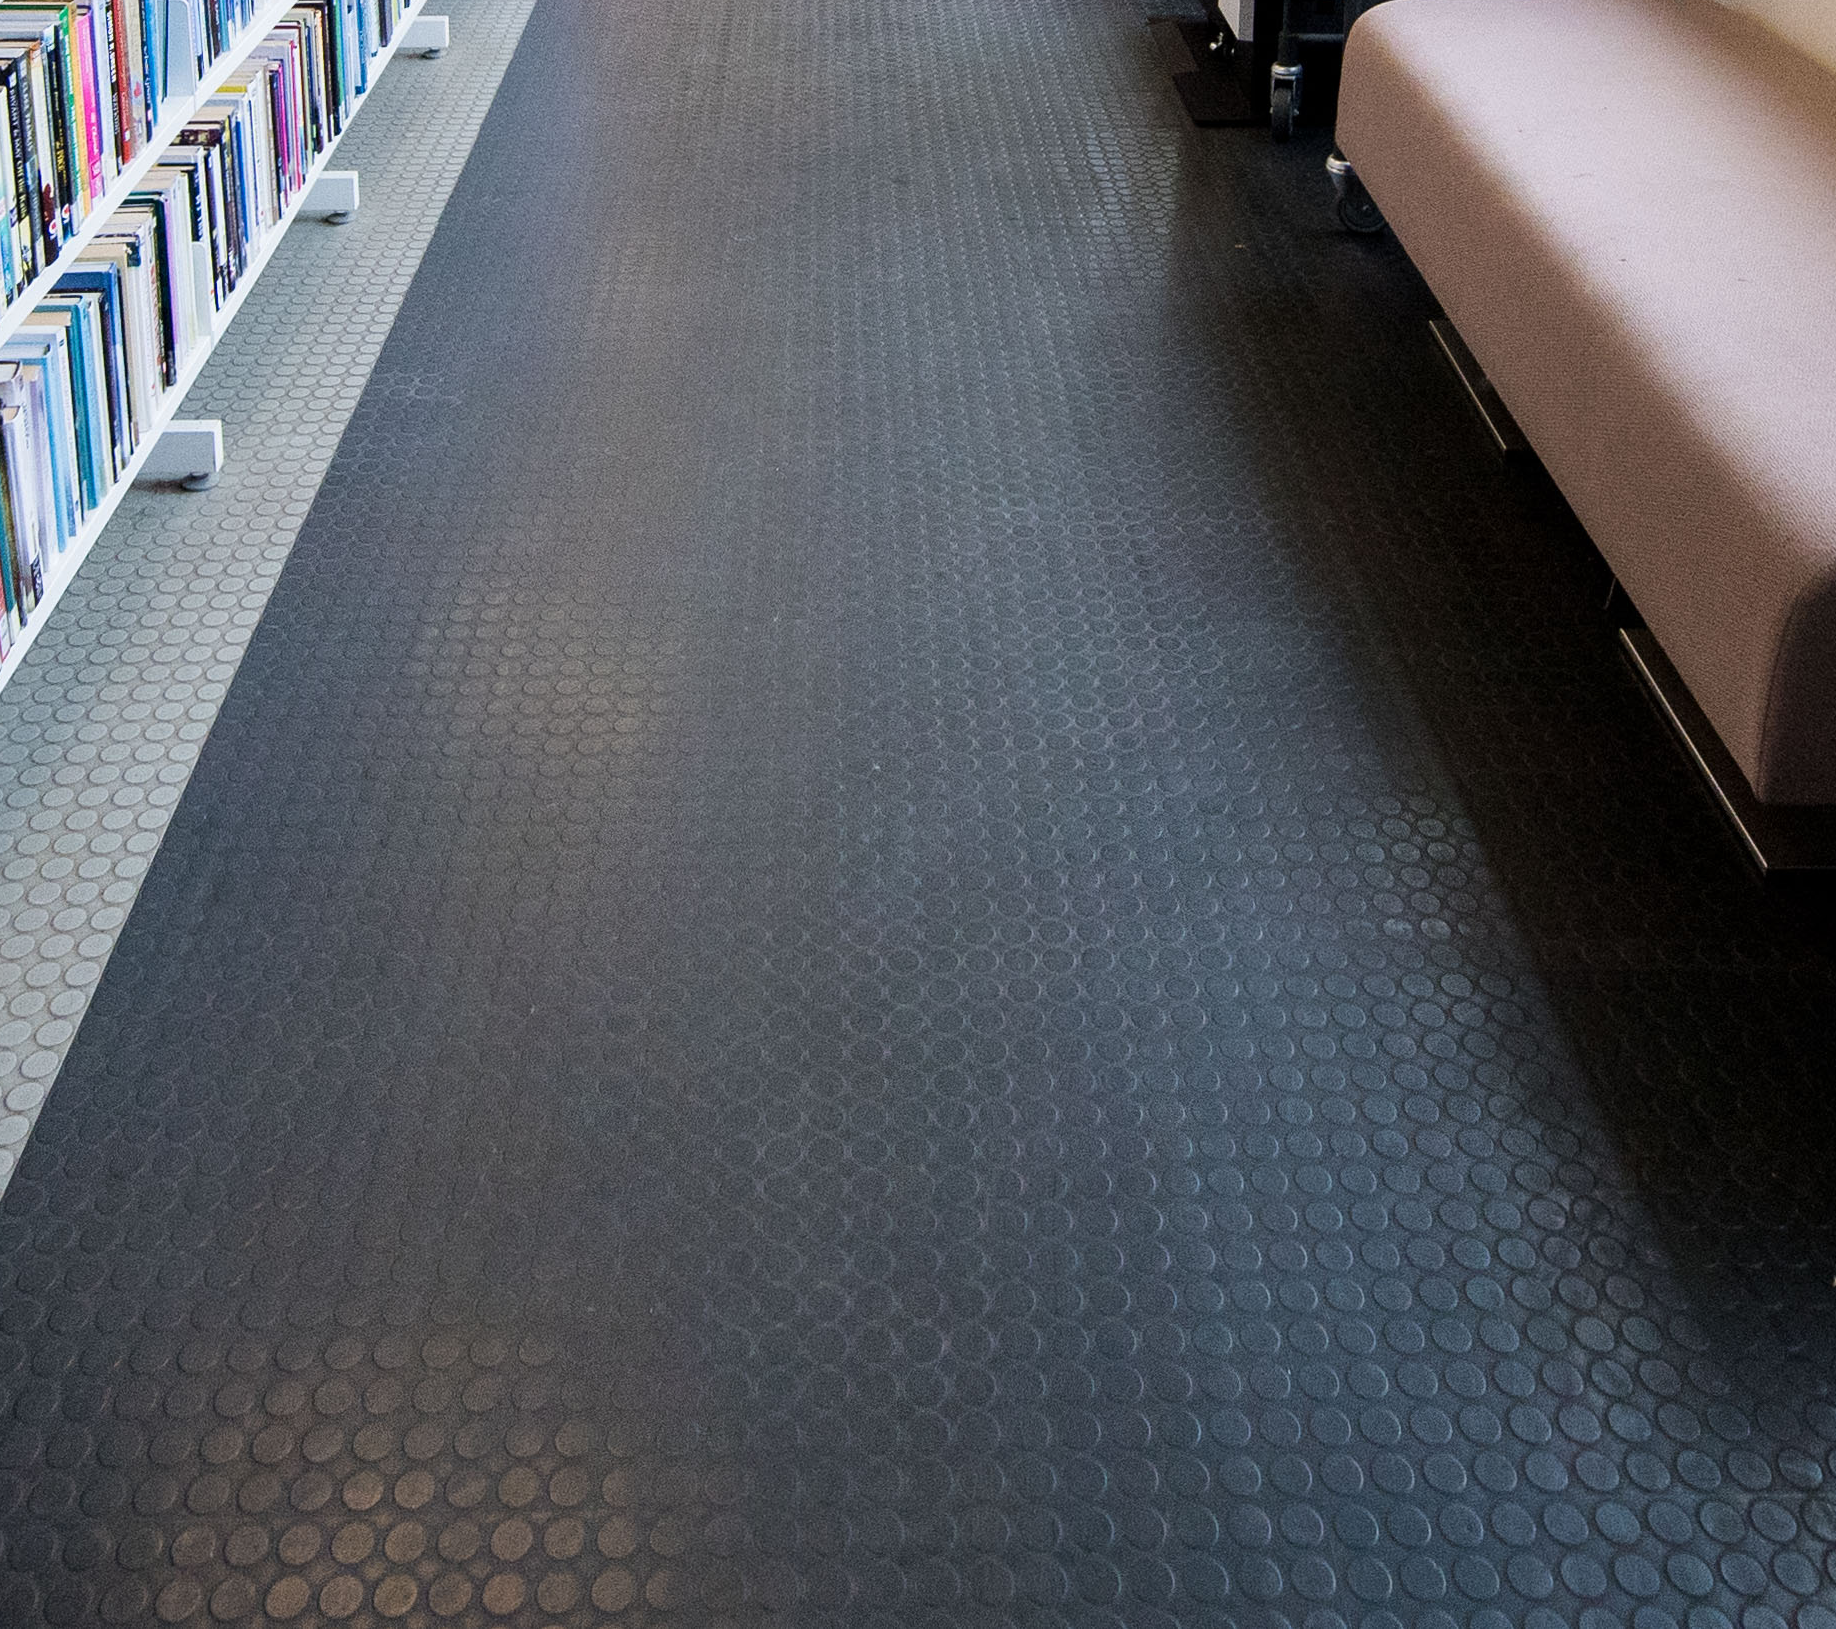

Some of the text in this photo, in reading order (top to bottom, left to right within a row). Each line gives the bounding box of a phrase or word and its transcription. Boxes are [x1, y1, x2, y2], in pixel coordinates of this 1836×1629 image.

[8, 88, 28, 218] BRYANT & MAY Off the Rails
